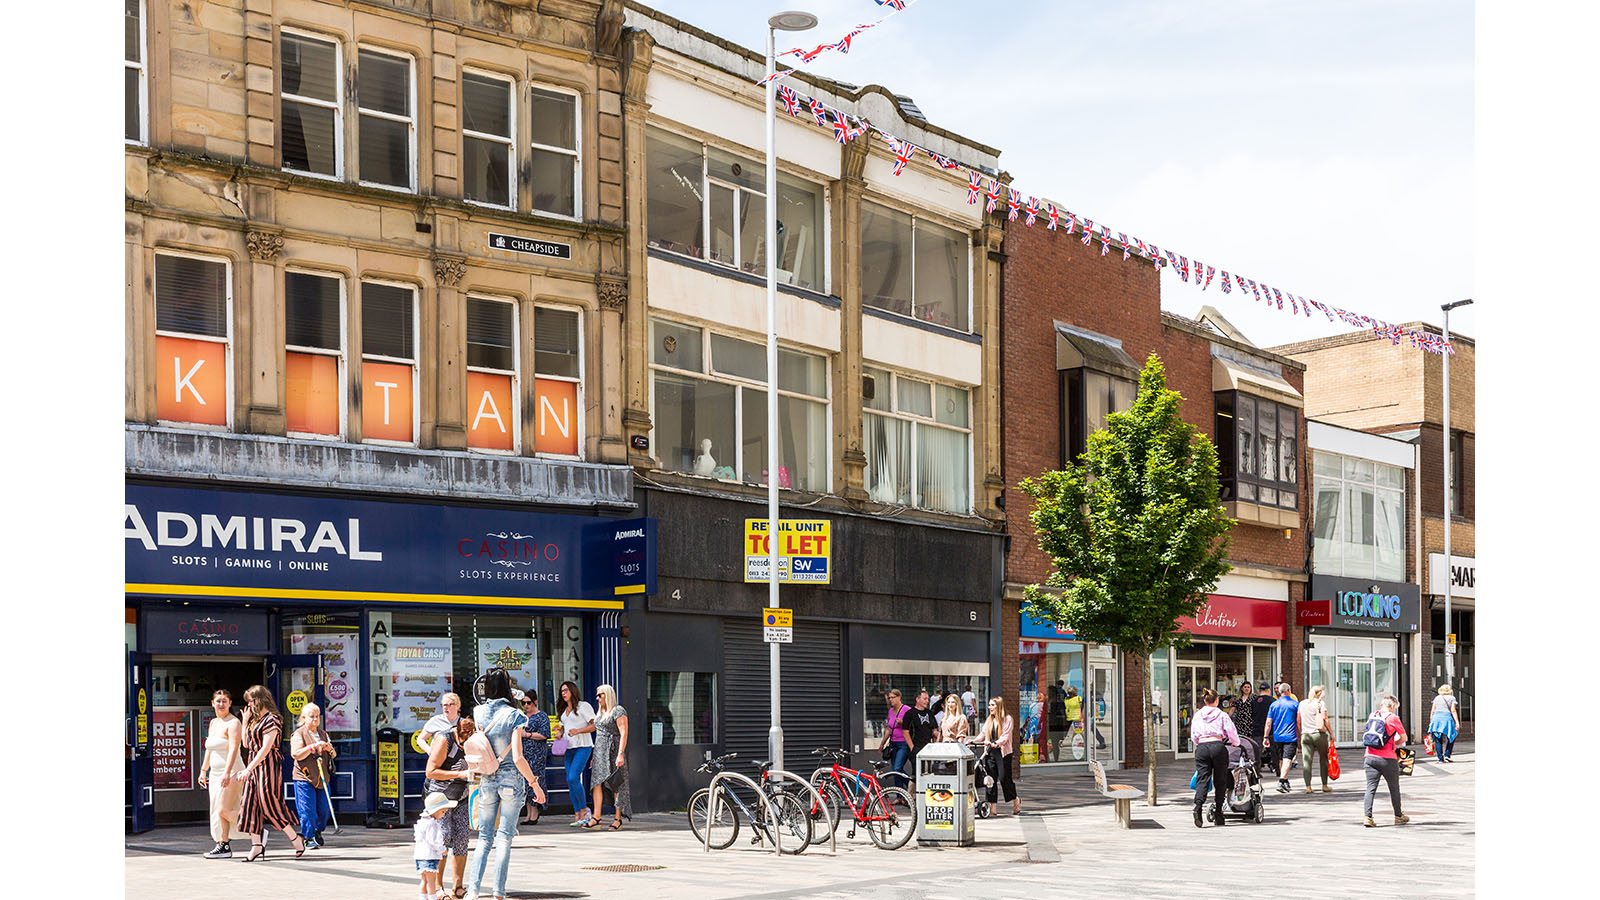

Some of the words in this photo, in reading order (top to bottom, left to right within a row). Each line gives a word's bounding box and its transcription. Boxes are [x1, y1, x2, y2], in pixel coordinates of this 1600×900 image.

[511, 240, 560, 255] CHEAPSIDE
[174, 356, 206, 405] K
[125, 504, 382, 561] ADMIRAL
[752, 522, 792, 532] REIL
[796, 523, 824, 532] UNIT
[615, 528, 645, 540] ADMIRAL
[458, 538, 559, 561] CASINO
[787, 536, 826, 554] LET
[172, 555, 207, 566] SLOTS
[225, 558, 272, 569] GAMING
[289, 561, 329, 571] ONLINE
[620, 563, 640, 573] SLOTS
[749, 558, 787, 566] reesdon
[794, 559, 812, 571] SW
[460, 570, 492, 580] SLOTS
[497, 571, 560, 582] EXPERIENCE
[672, 589, 681, 600] 4
[306, 614, 326, 624] SLOTS
[970, 611, 976, 621] 6
[1196, 602, 1237, 627] Clintons
[178, 622, 239, 633] CASINO
[397, 648, 422, 658] ROYAL
[423, 648, 444, 658] CASH
[499, 649, 517, 659] EYE
[567, 626, 580, 681] CAS
[496, 661, 522, 670] QUEEN
[371, 620, 389, 730] ADMIRA
[153, 723, 186, 736] REE
[153, 738, 186, 746] NBED
[153, 748, 186, 756] SSION
